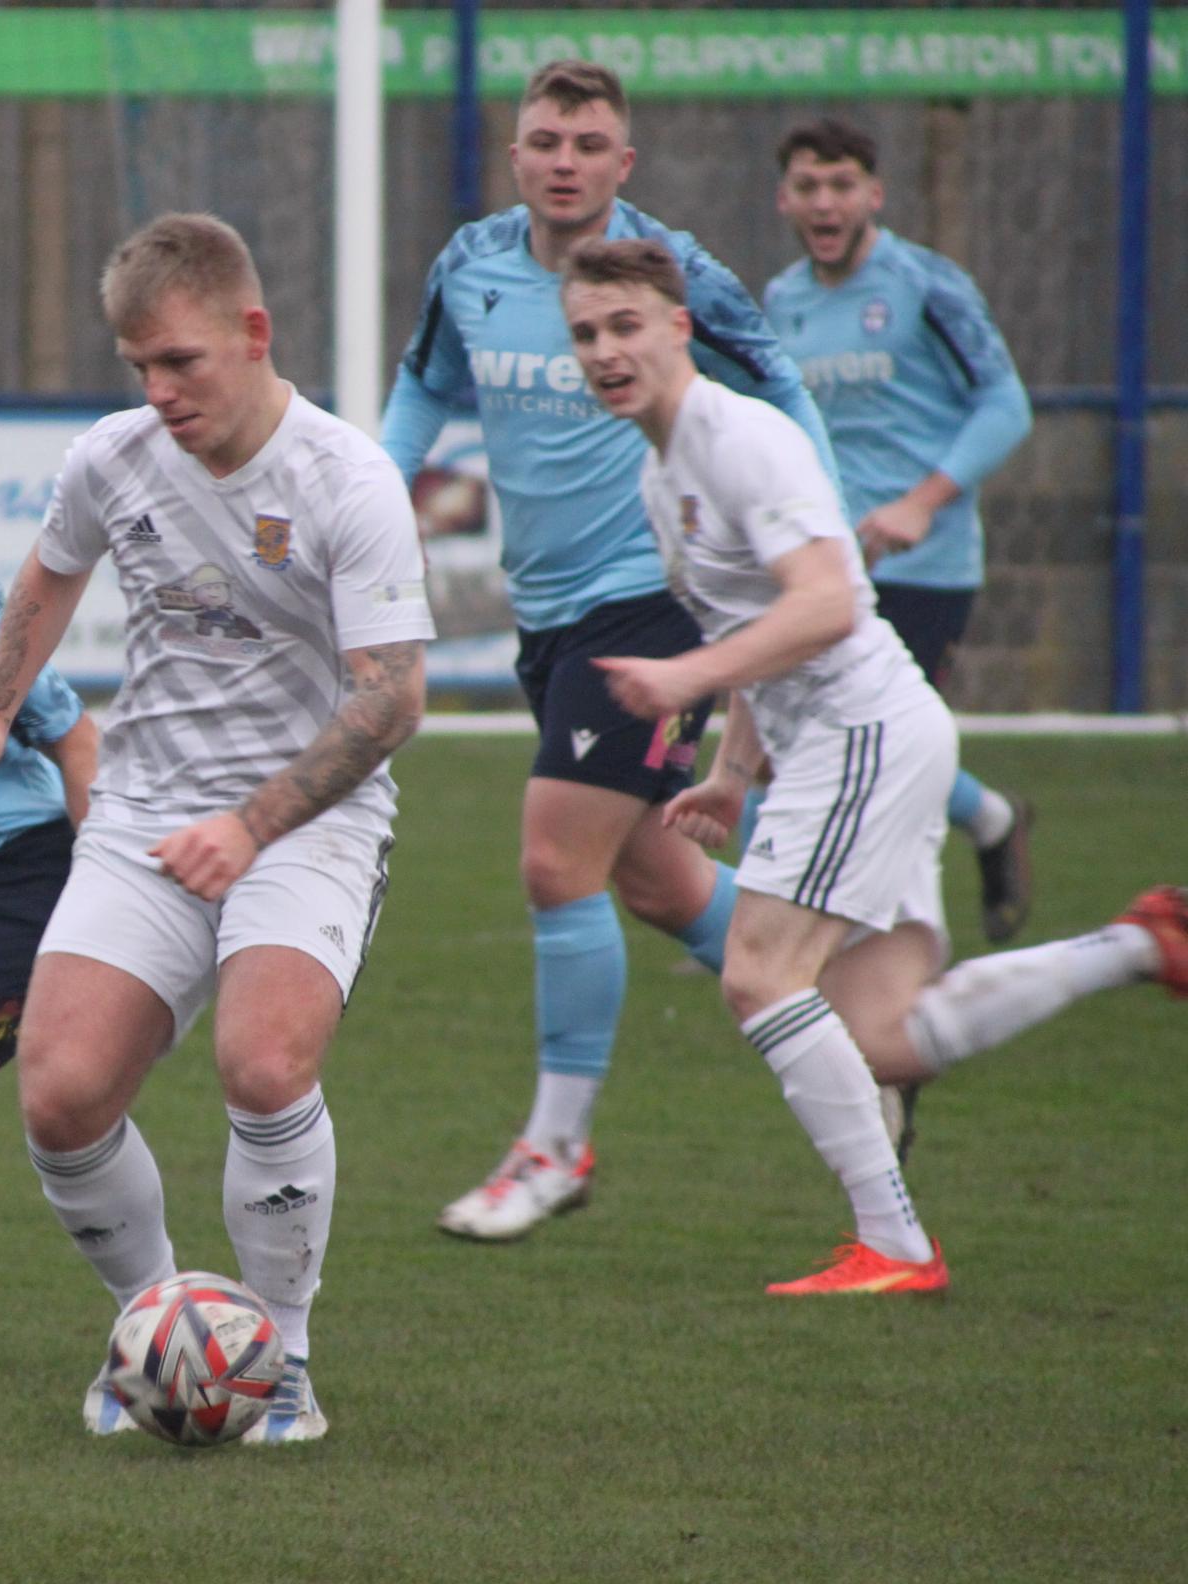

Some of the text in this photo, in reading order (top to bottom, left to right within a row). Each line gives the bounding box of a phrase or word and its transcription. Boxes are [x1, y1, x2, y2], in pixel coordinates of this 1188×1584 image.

[251, 25, 405, 66] wrn
[586, 35, 644, 76] TO
[472, 350, 595, 396] wre
[244, 1193, 318, 1216] adidas
